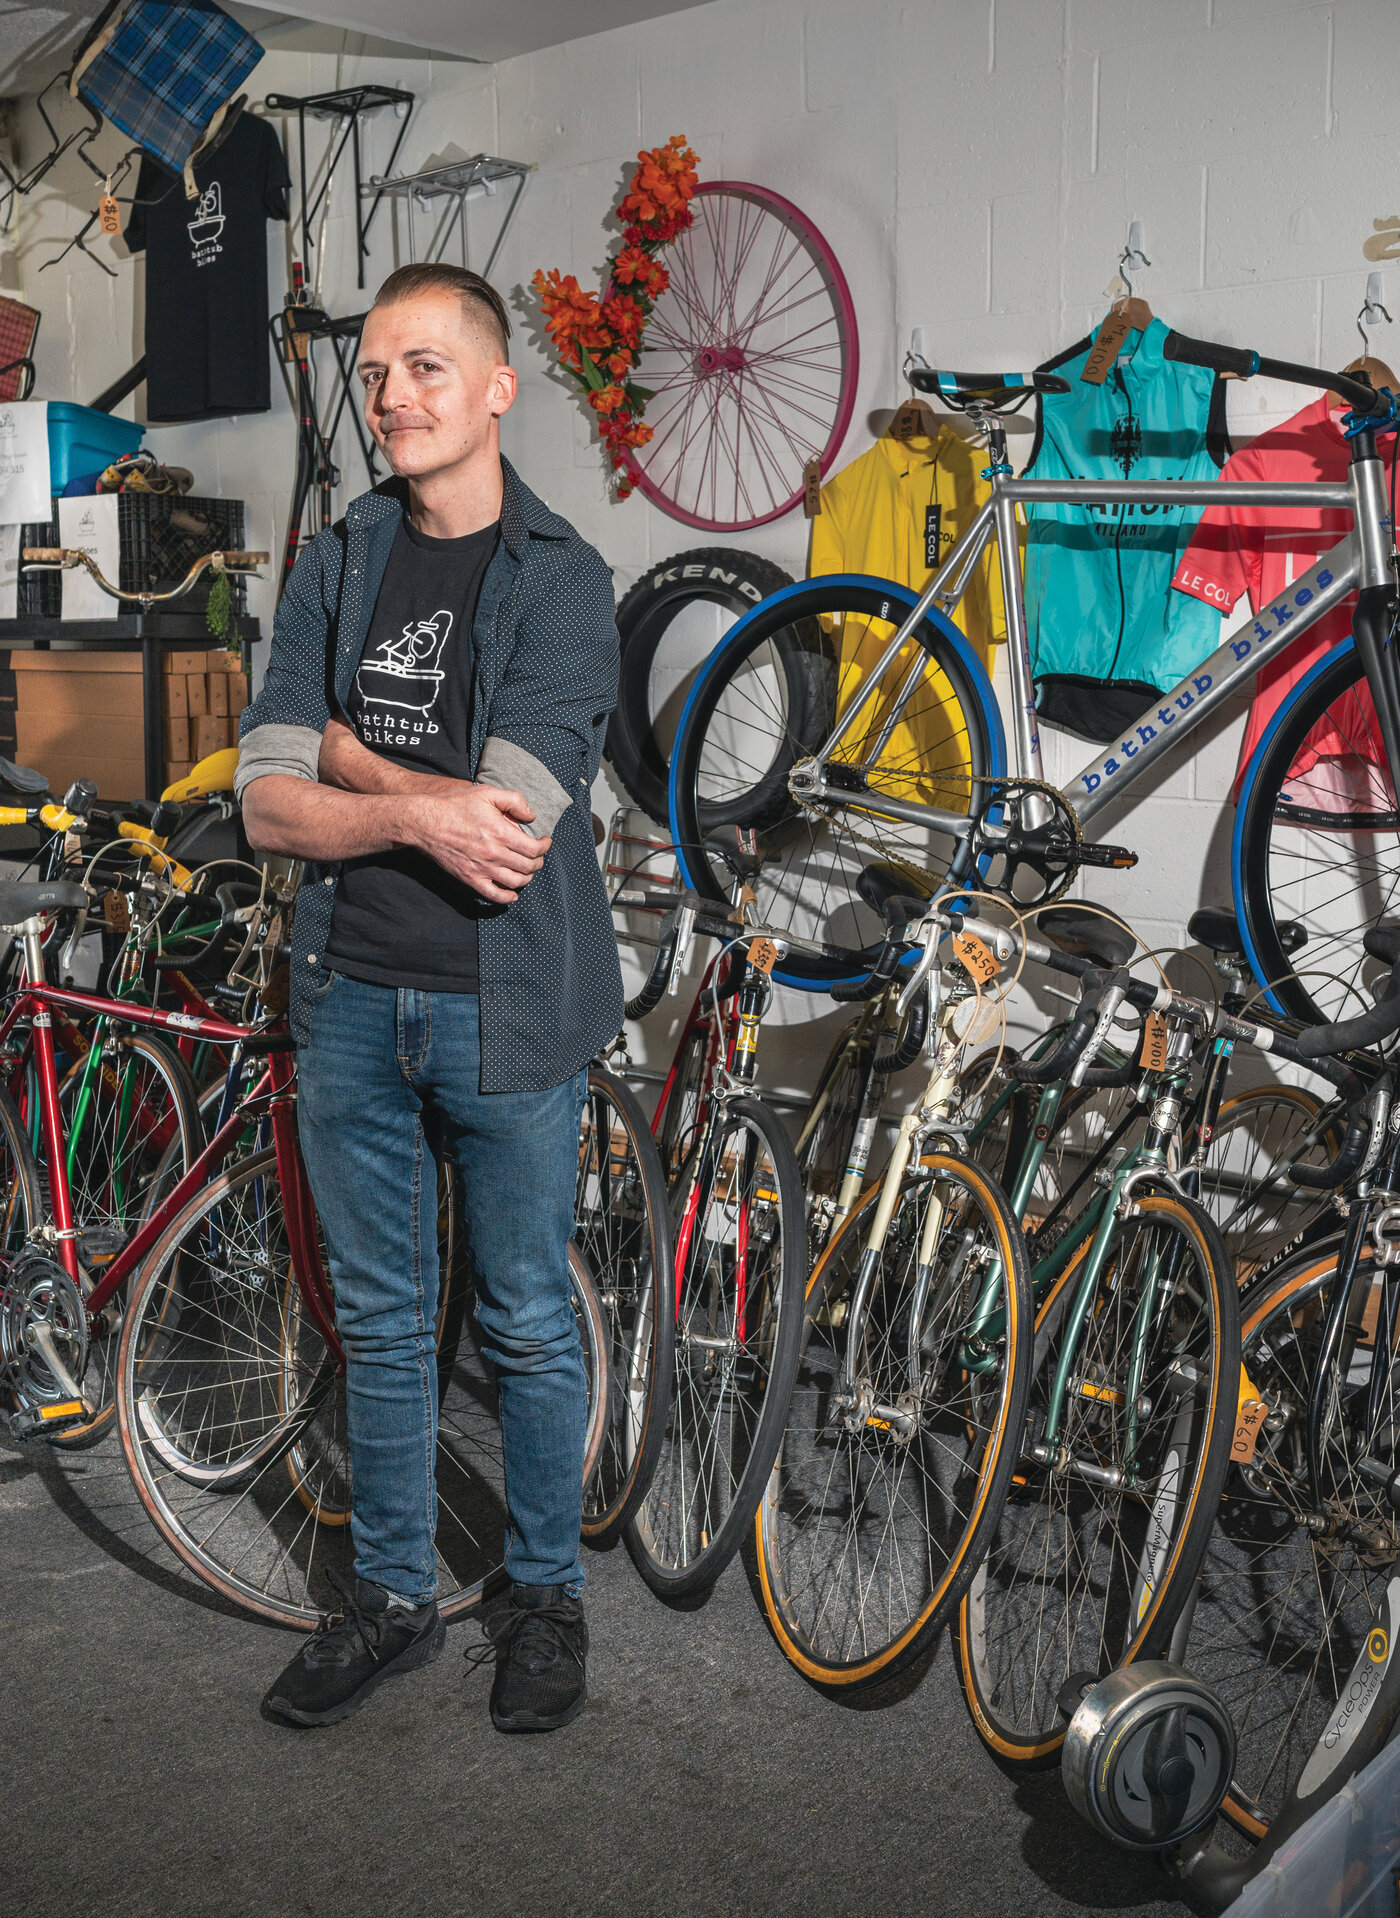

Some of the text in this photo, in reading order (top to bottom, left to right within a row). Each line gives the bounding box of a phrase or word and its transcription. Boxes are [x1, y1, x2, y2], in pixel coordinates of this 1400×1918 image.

[104, 204, 118, 232] $60
[1085, 335, 1115, 376] $100
[927, 514, 937, 564] LE COL
[653, 564, 764, 603] KEND
[1180, 570, 1232, 607] LE COL
[1081, 568, 1335, 794] bathtub bikes
[356, 710, 440, 734] bathtub
[363, 728, 422, 745] bikes
[961, 941, 995, 977] $250
[1150, 1026, 1165, 1067] $400
[1233, 1414, 1259, 1453] $60
[1324, 1662, 1374, 1752] CycleOps
[1357, 1671, 1381, 1714] POWER
